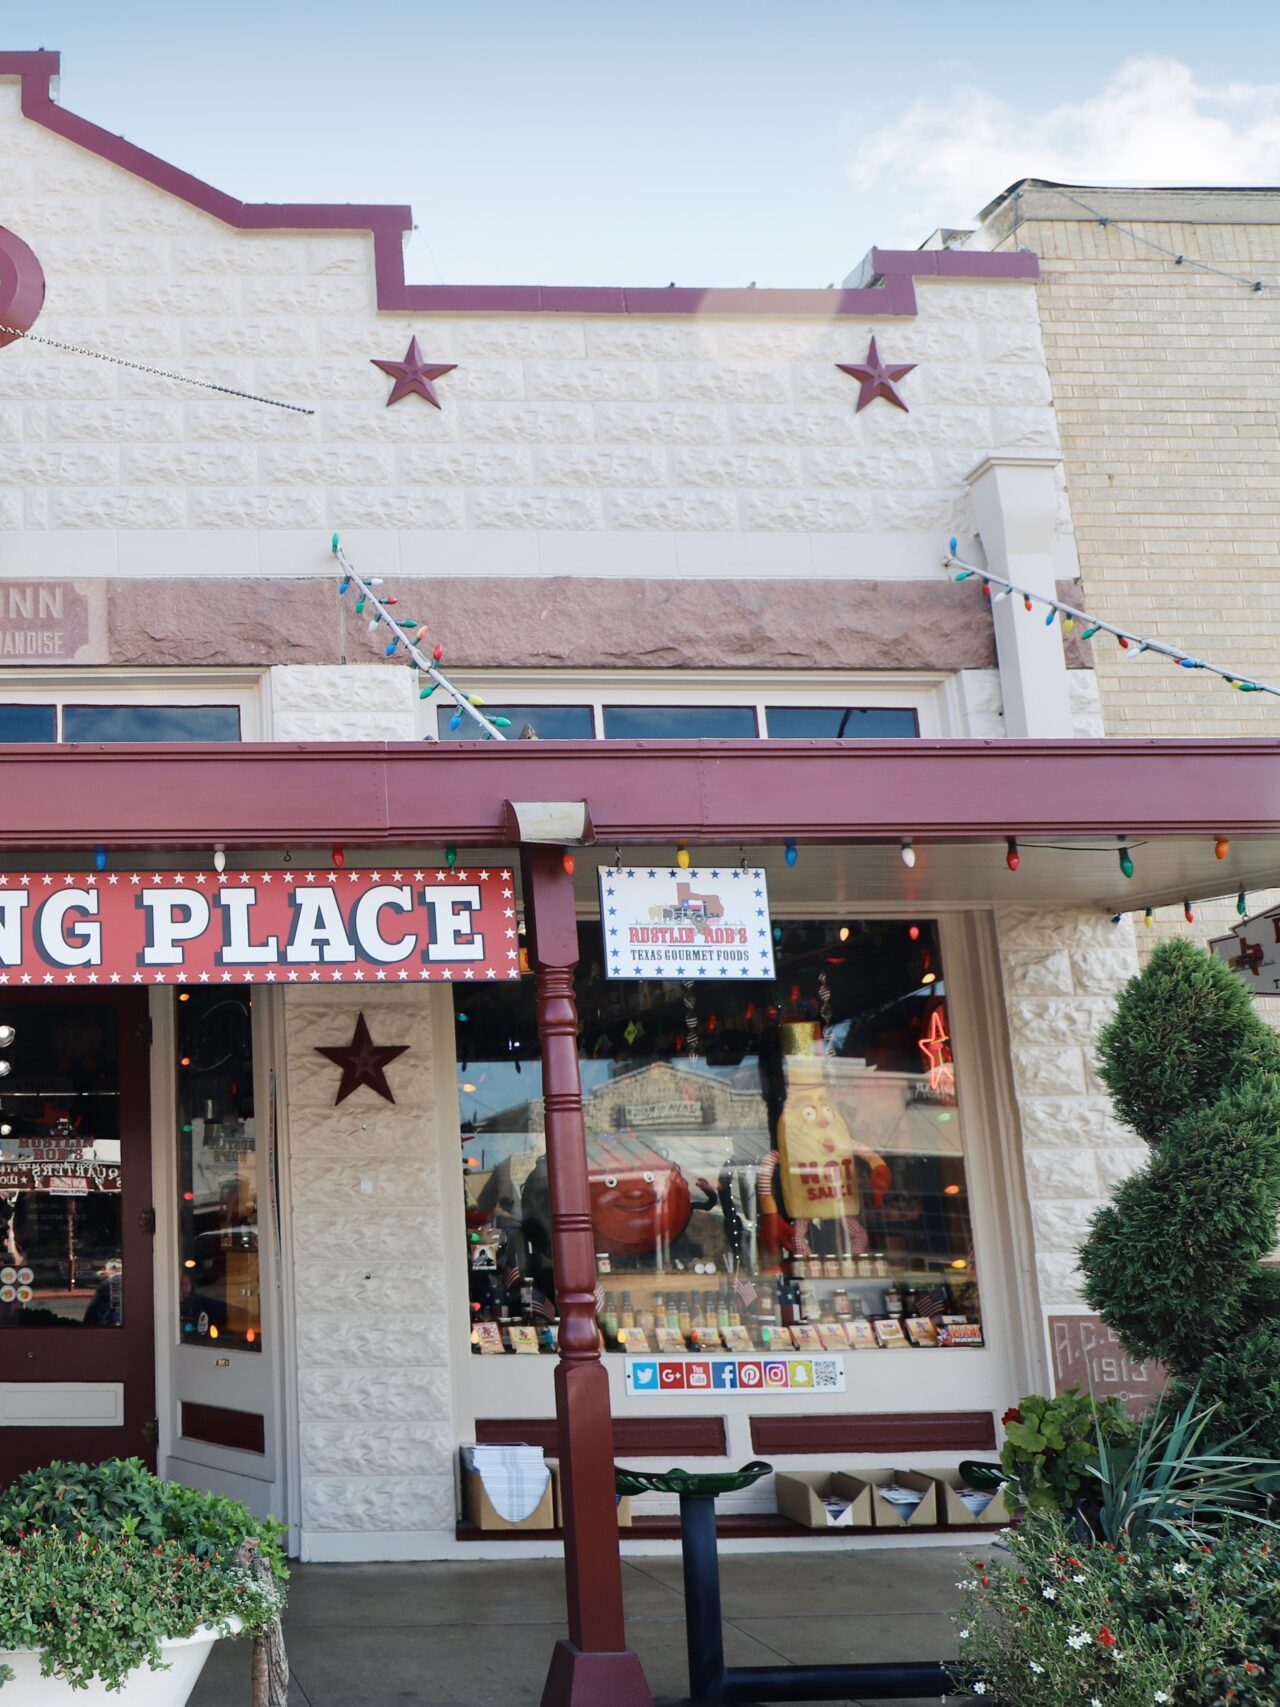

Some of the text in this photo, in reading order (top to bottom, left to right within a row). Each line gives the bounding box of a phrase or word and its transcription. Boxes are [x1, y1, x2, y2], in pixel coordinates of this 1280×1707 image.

[136, 885, 486, 967] PLACE
[704, 926, 748, 944] ROB'S
[631, 950, 749, 961] TEXAS GOURMET FOODS
[798, 1159, 852, 1185] HOT
[691, 1365, 703, 1373] You
